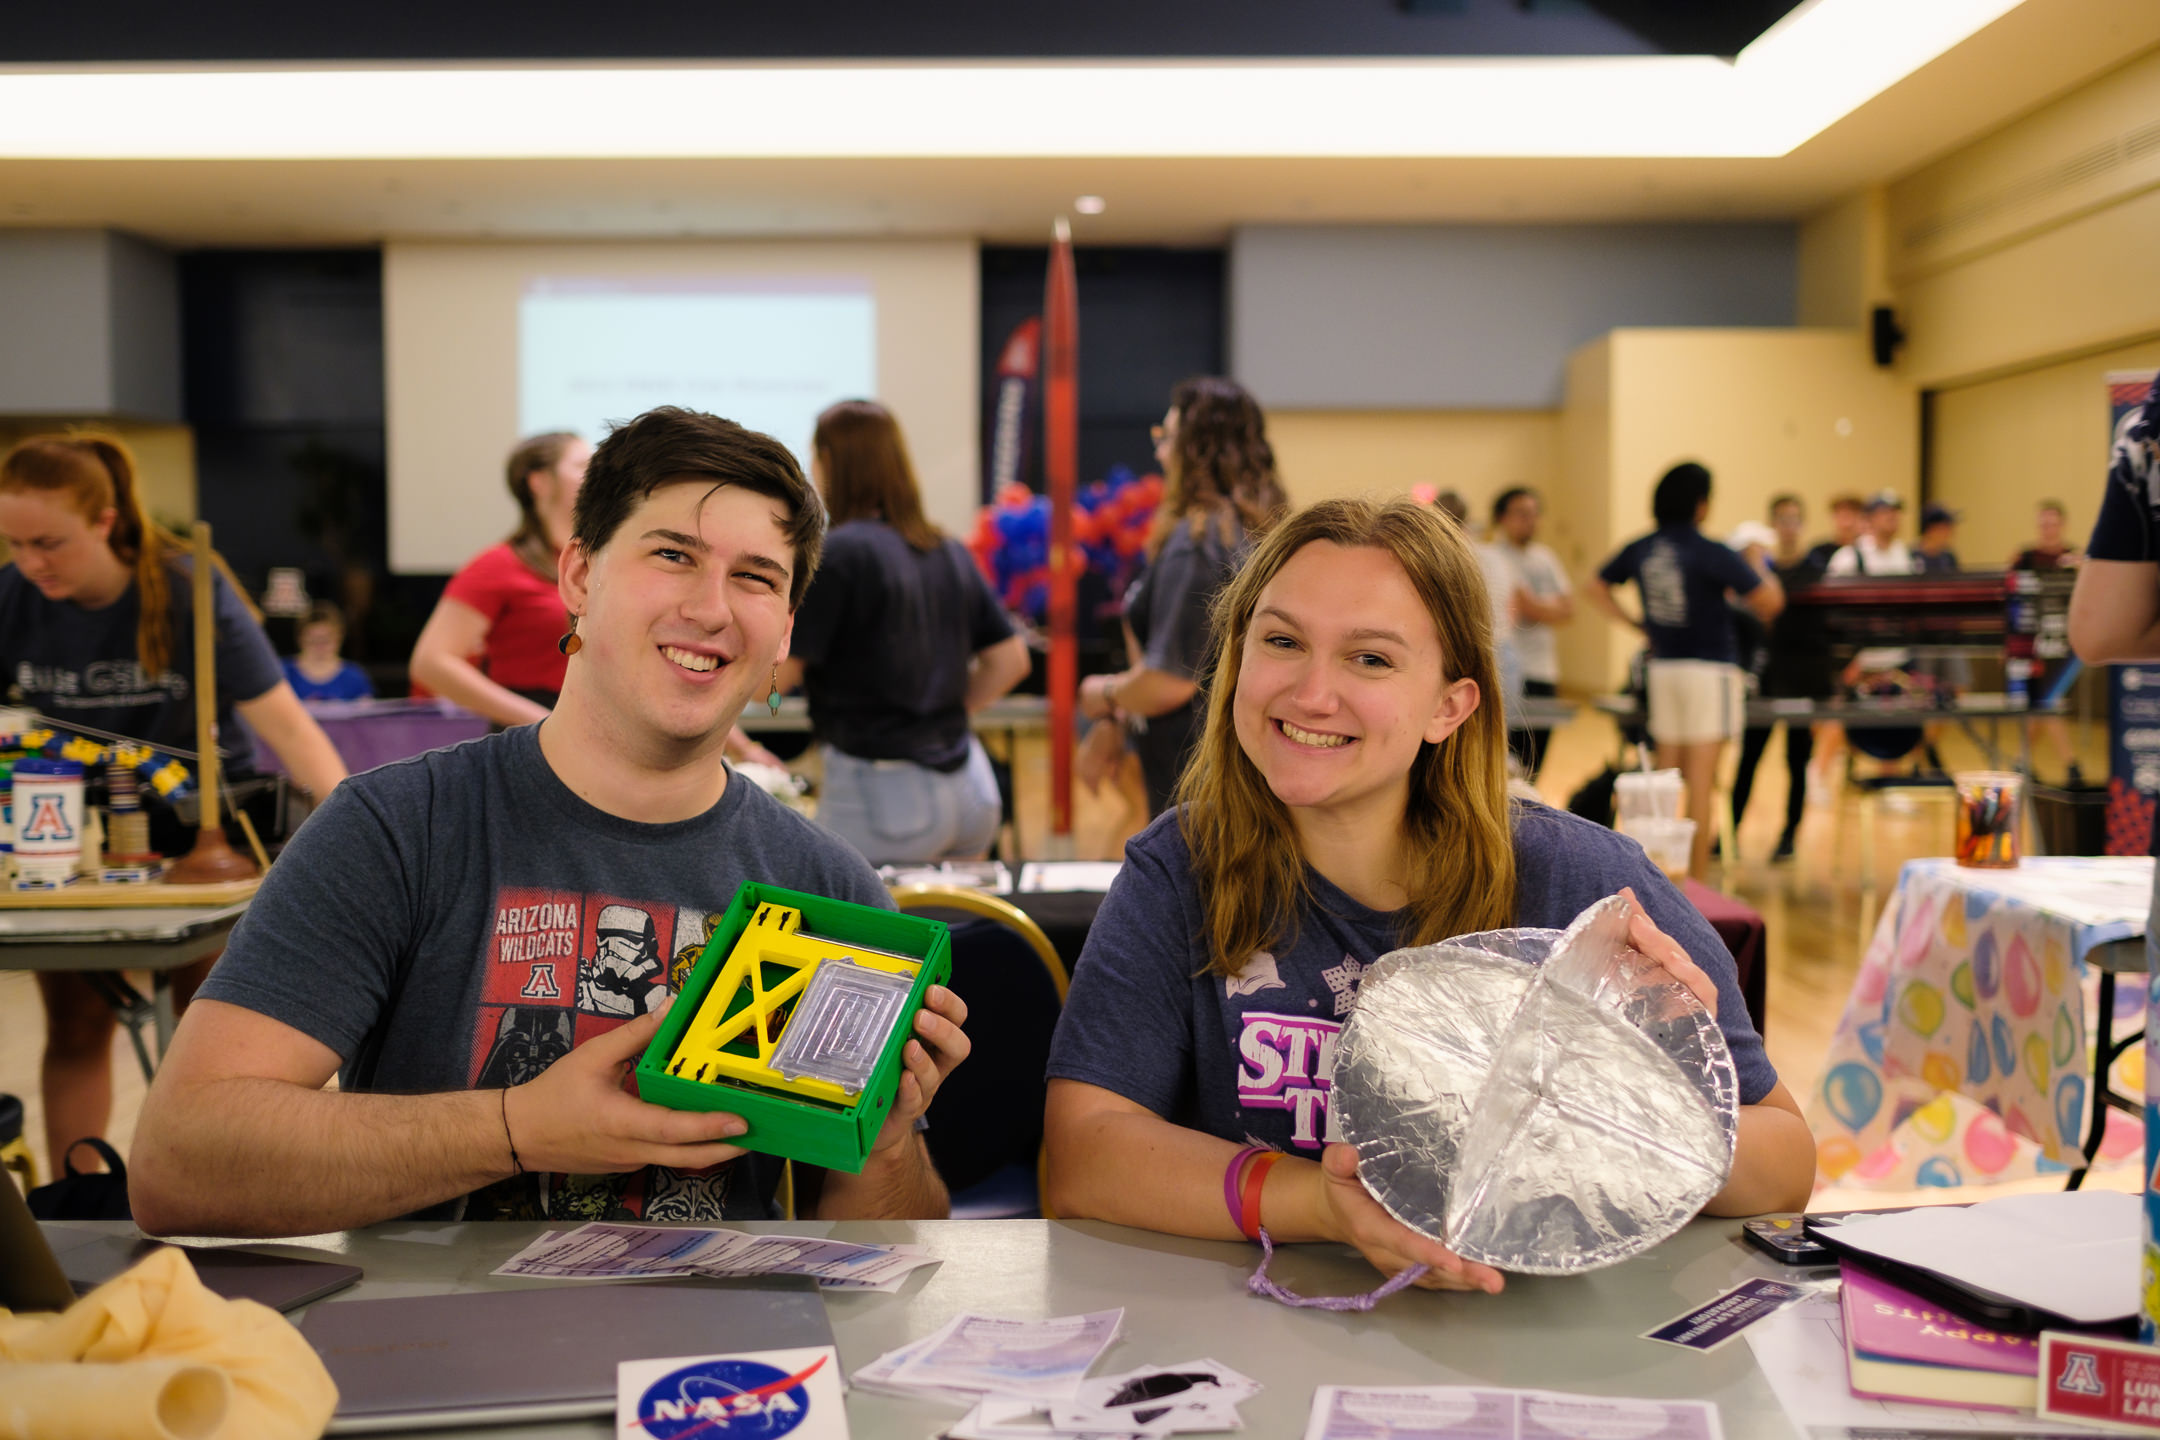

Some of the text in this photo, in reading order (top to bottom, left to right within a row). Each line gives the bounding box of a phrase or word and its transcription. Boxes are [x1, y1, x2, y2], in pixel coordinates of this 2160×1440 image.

[22, 794, 73, 840] A
[495, 903, 577, 934] ARIZONA
[500, 931, 574, 962] WILDCATS
[520, 963, 560, 998] A
[2057, 1351, 2105, 1396] A
[653, 1391, 800, 1421] NASA
